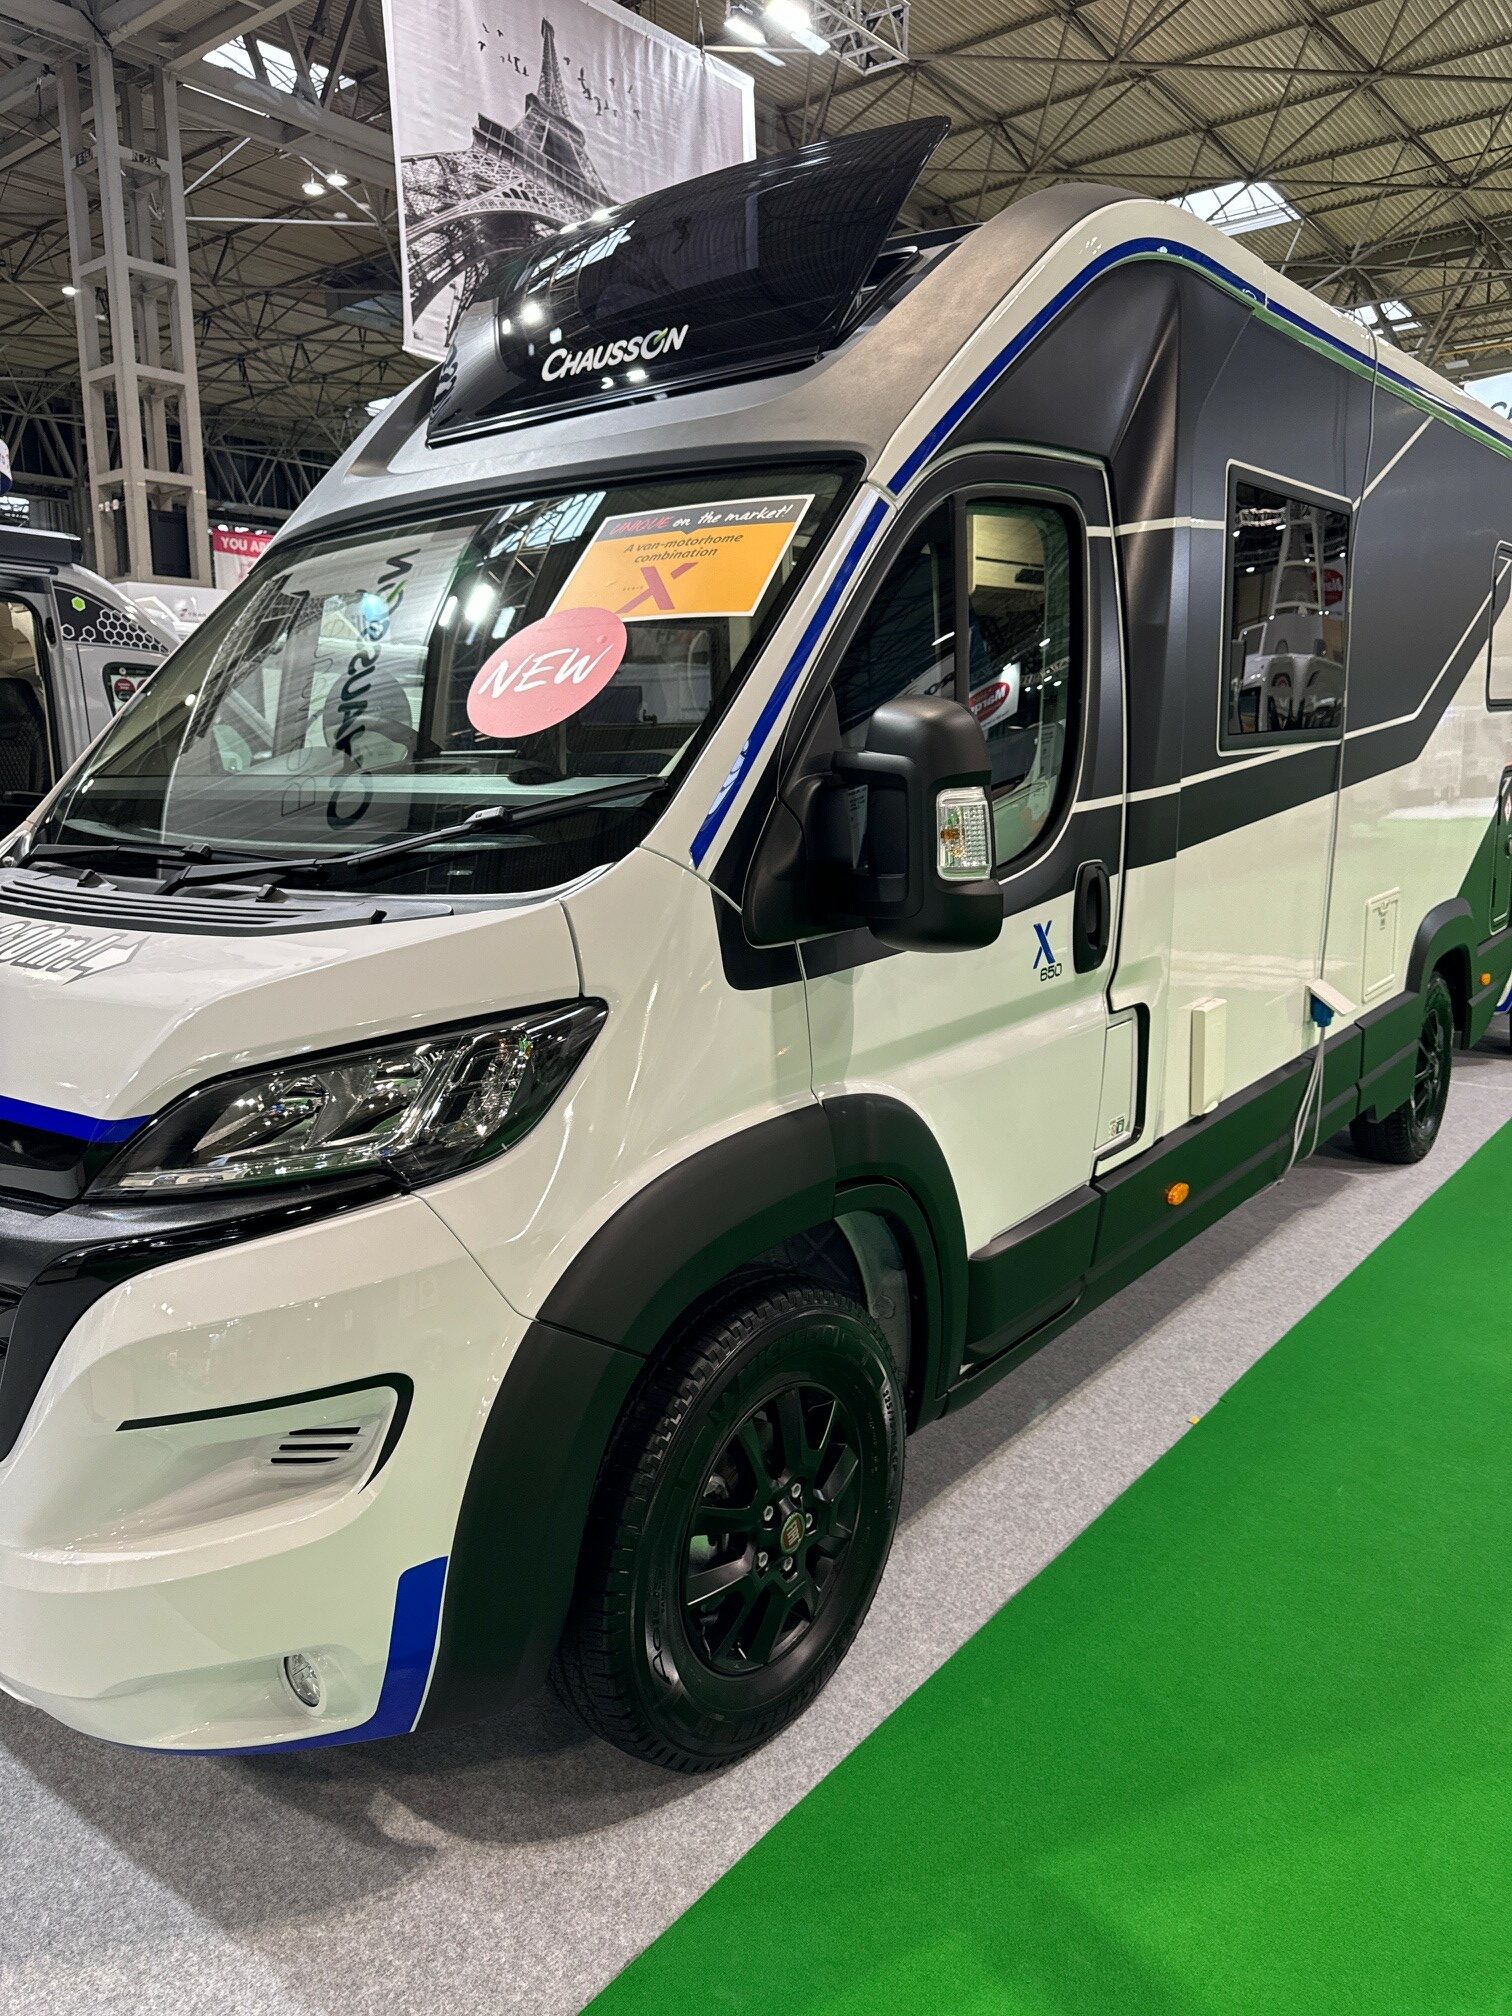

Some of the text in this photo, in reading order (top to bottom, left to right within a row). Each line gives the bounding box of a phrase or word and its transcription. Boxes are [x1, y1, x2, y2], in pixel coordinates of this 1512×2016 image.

[541, 324, 690, 382] CHAUSSON
[610, 504, 794, 535] UNIQUE on the market!
[220, 536, 271, 552] YOU AR
[624, 533, 744, 554] A van-motorhome
[634, 547, 718, 564] combination
[477, 642, 615, 699] NEW
[1033, 920, 1056, 970] X
[1040, 962, 1063, 982] 650
